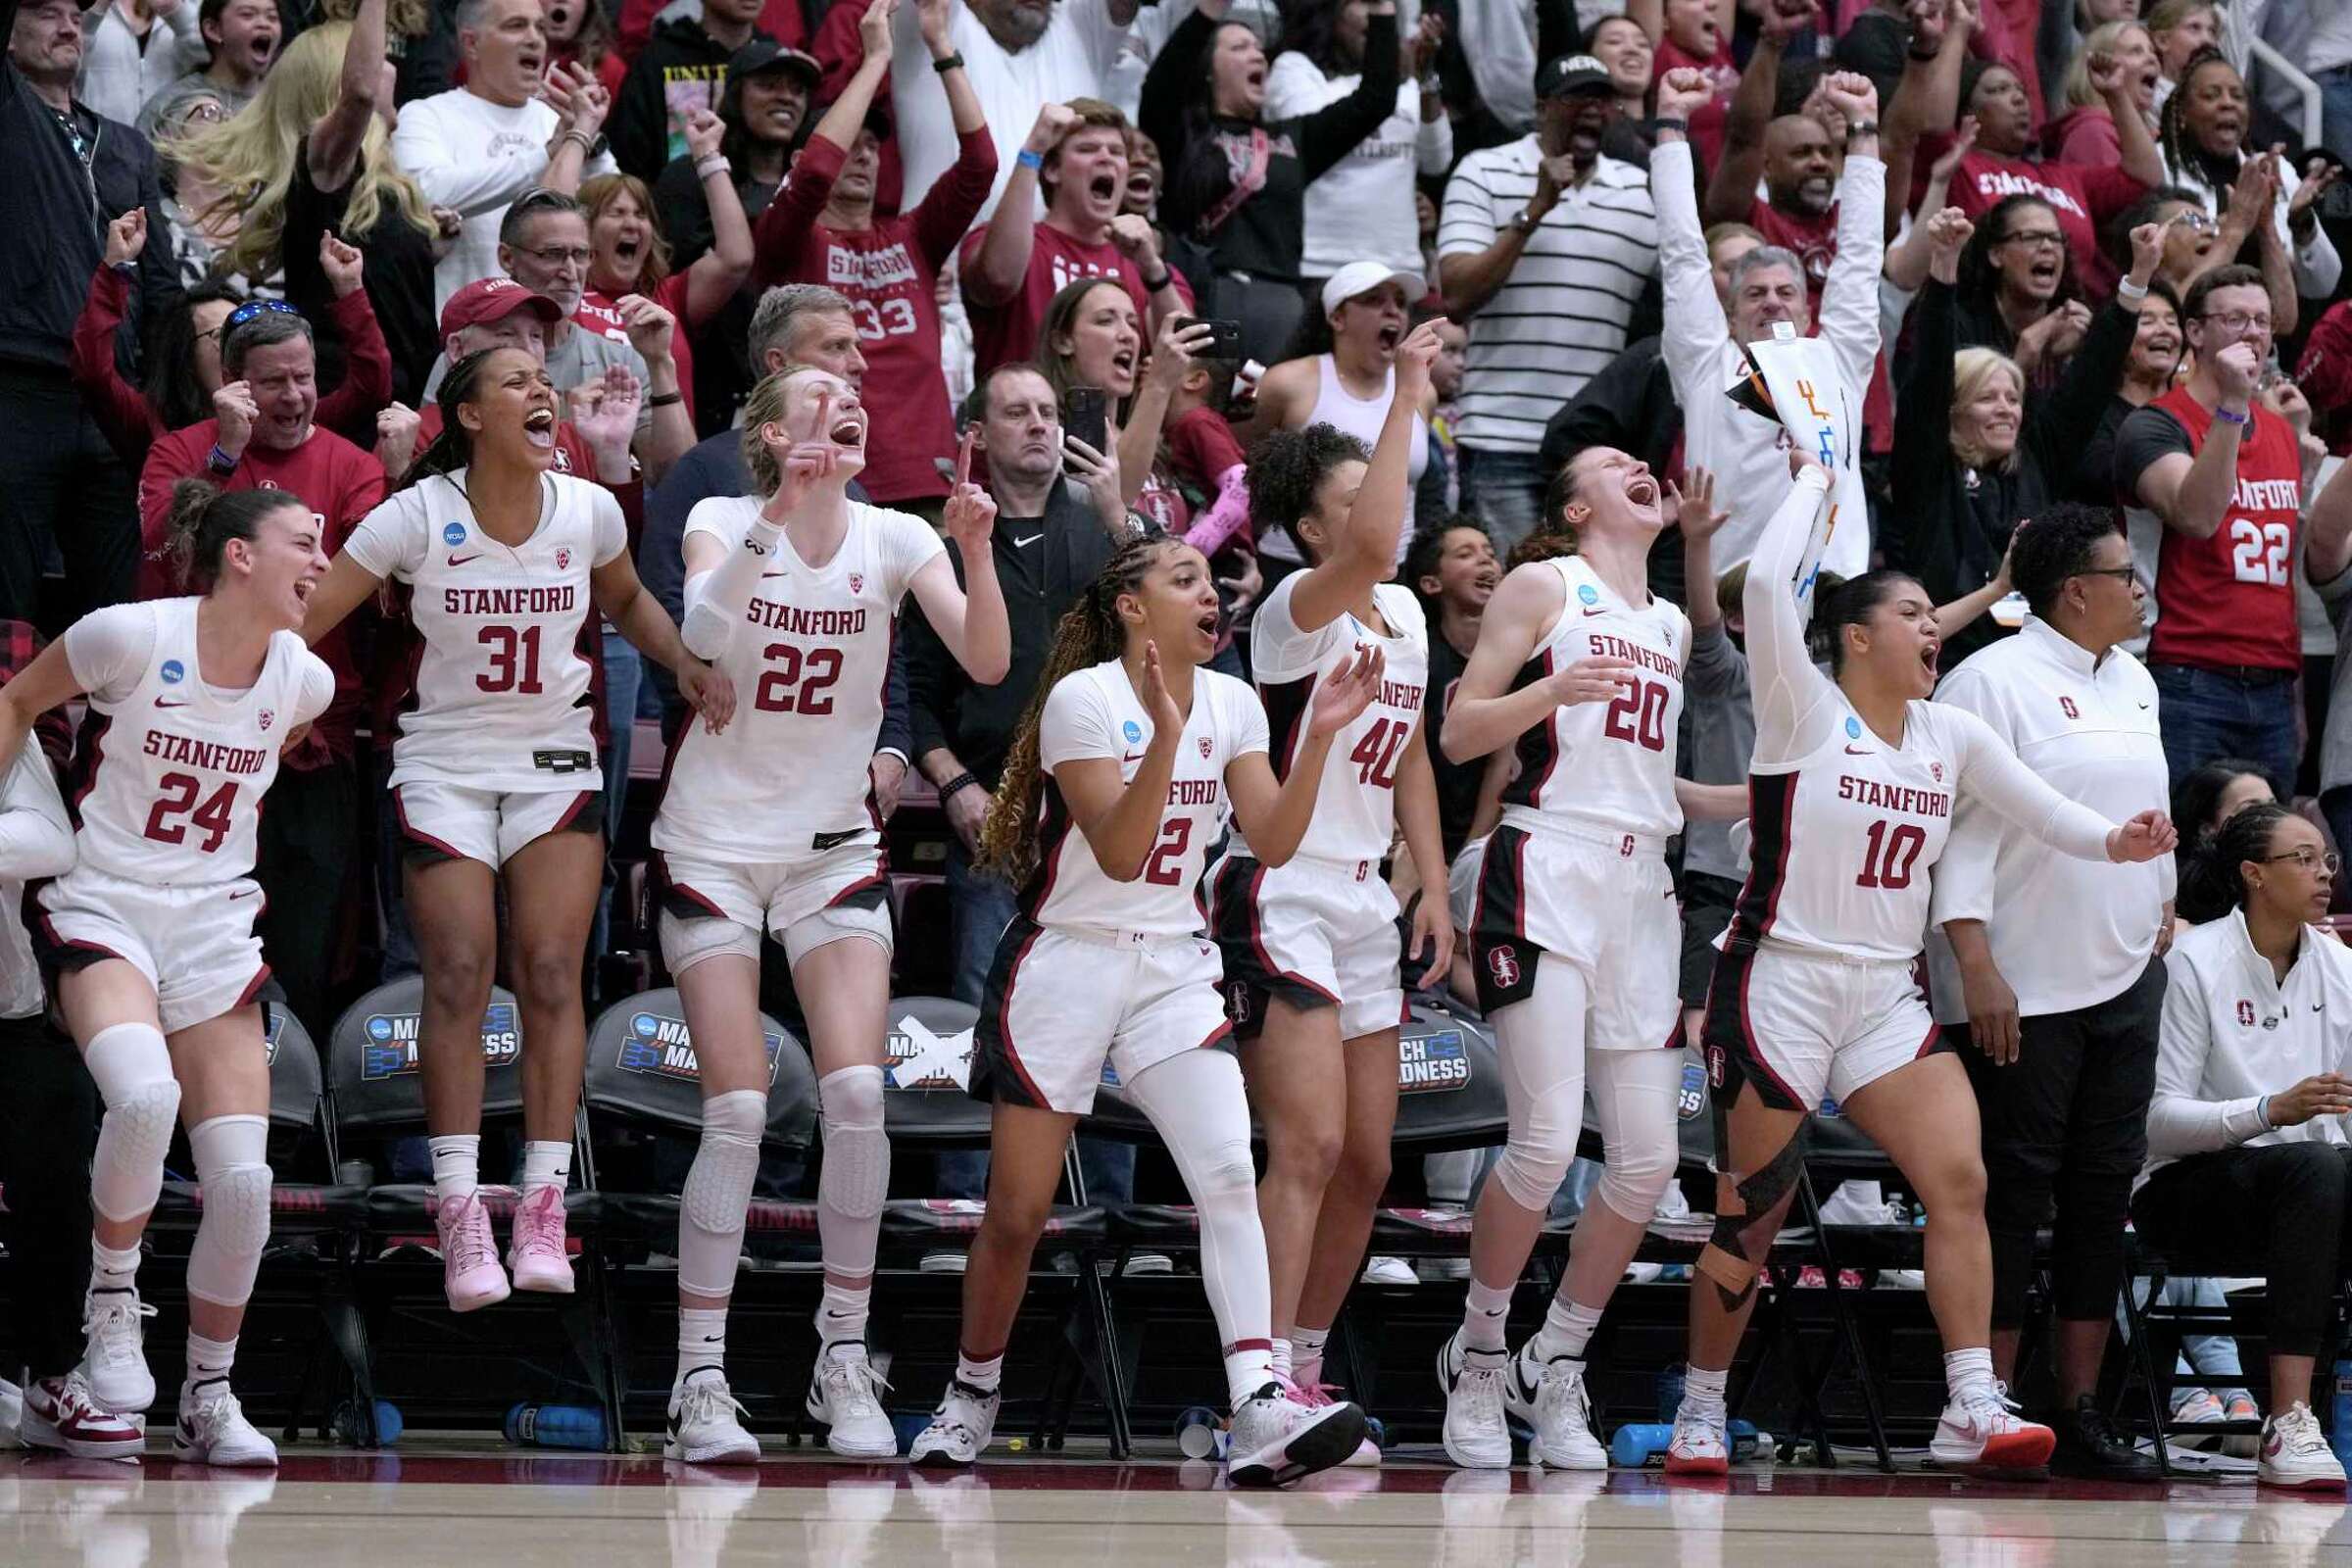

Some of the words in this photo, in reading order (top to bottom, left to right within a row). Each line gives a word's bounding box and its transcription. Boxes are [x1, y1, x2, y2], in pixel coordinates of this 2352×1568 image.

[855, 298, 917, 340] 33
[2230, 477, 2299, 512] ANFOR
[2230, 517, 2290, 587] 22
[445, 585, 574, 613] STANFORD
[747, 597, 865, 636] STANFORD
[476, 625, 543, 694] 31
[755, 643, 844, 715] 22
[1589, 634, 1683, 684] STANFORD
[1372, 680, 1425, 711] ANFOR
[1604, 675, 1670, 753] 20
[144, 729, 268, 774] STANFORD
[1350, 717, 1408, 790] 40
[144, 772, 240, 854] 24
[1167, 780, 1217, 806] FORD
[1838, 774, 1949, 817] STANFORD
[1135, 817, 1193, 886] 2
[1855, 819, 1928, 890] 10
[1398, 1058, 1467, 1085] DNESS
